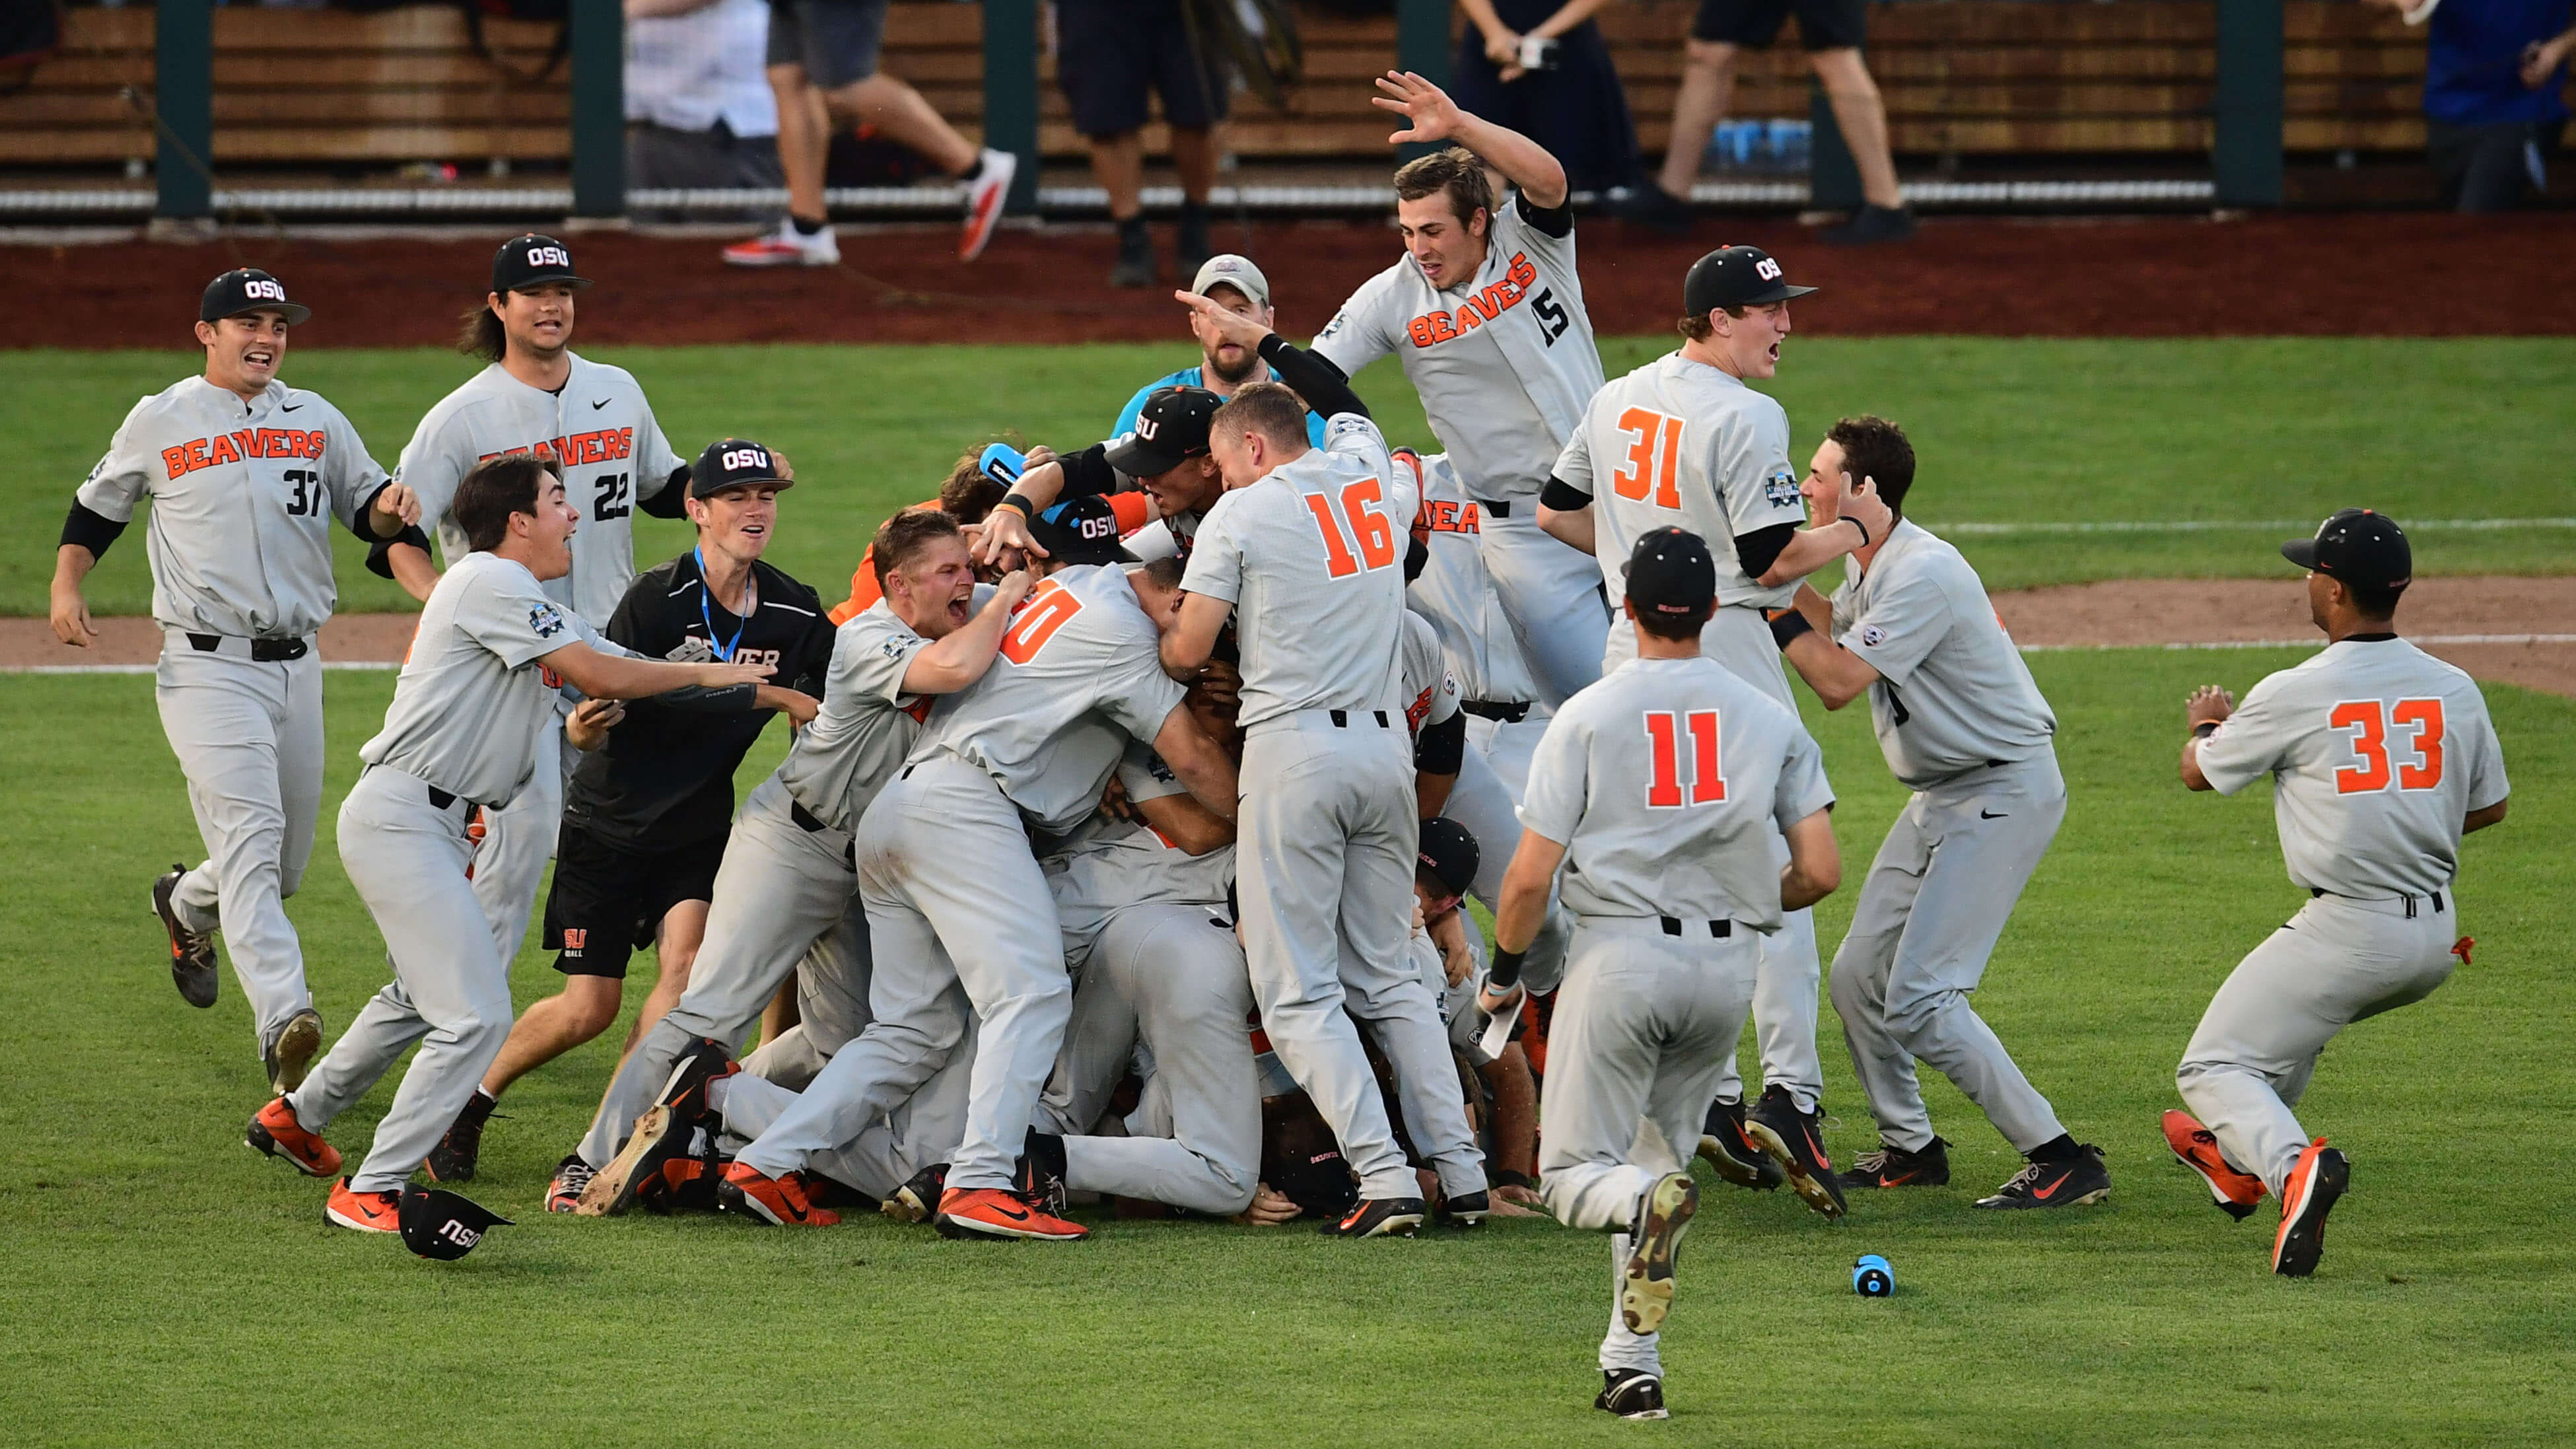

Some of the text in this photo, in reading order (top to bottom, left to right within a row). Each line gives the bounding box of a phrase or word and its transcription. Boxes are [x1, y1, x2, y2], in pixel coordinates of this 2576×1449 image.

[527, 246, 569, 267] OSU
[1755, 257, 1783, 281] OS
[244, 280, 285, 302] OSU
[1531, 286, 1569, 348] 15
[479, 427, 633, 467] AVERS
[1136, 413, 1160, 441] SU
[162, 427, 326, 481] BEAVERS
[722, 448, 767, 471] OSU
[1613, 405, 1687, 511] 31
[284, 470, 322, 517] 37
[594, 472, 629, 522] 22
[1082, 514, 1117, 539] OSU
[1305, 477, 1395, 581] 16
[1643, 709, 1727, 810] 11
[2327, 697, 2445, 796] 33
[564, 928, 587, 948] SU
[438, 1219, 481, 1248] OSU
